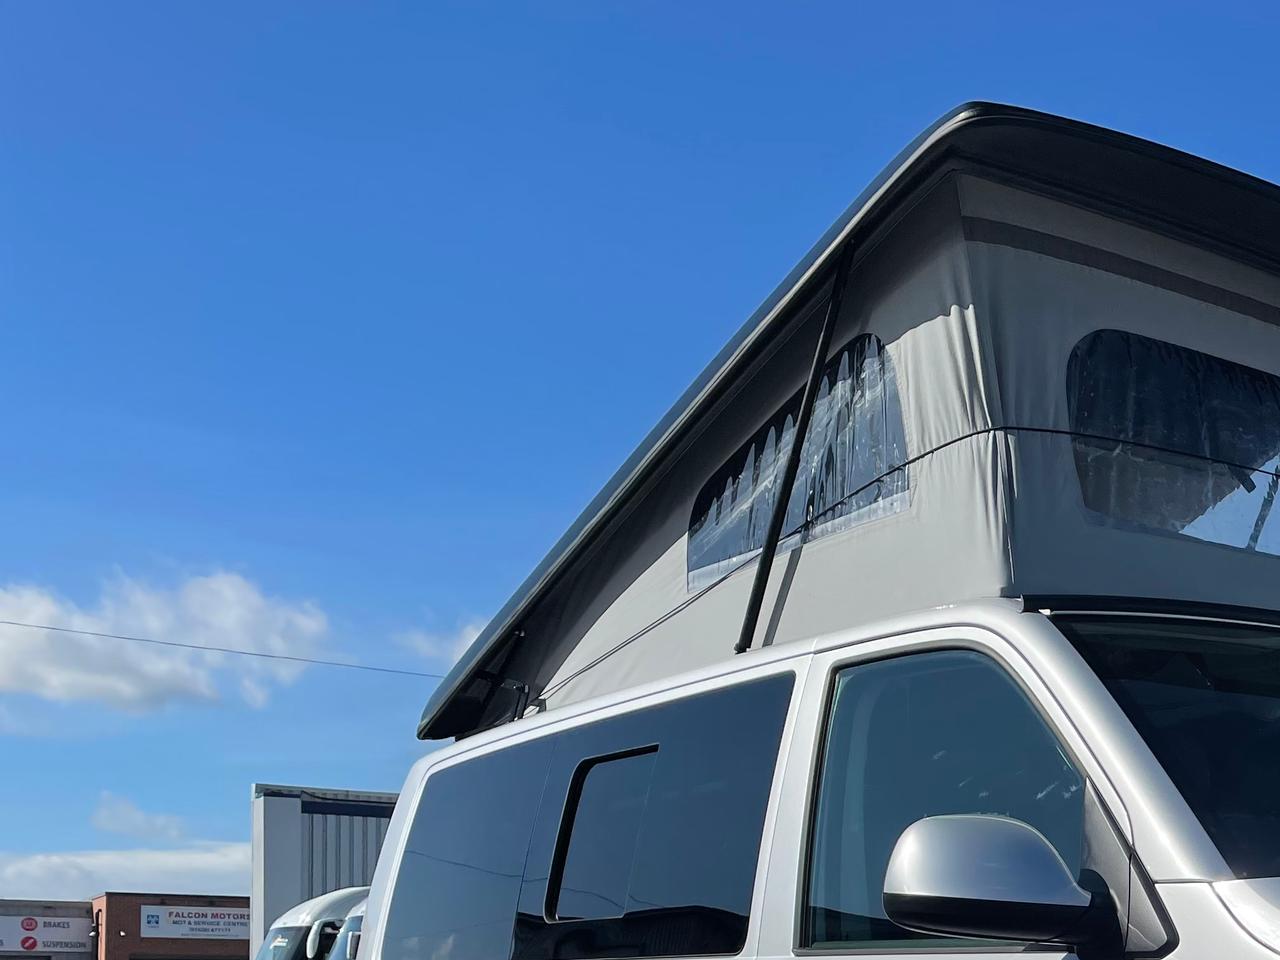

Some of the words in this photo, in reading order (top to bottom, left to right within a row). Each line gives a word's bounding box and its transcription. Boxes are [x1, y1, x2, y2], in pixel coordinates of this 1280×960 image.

[168, 911, 208, 919] FALCON
[43, 921, 70, 929] BRAKES
[42, 941, 87, 949] SUSPENSION
